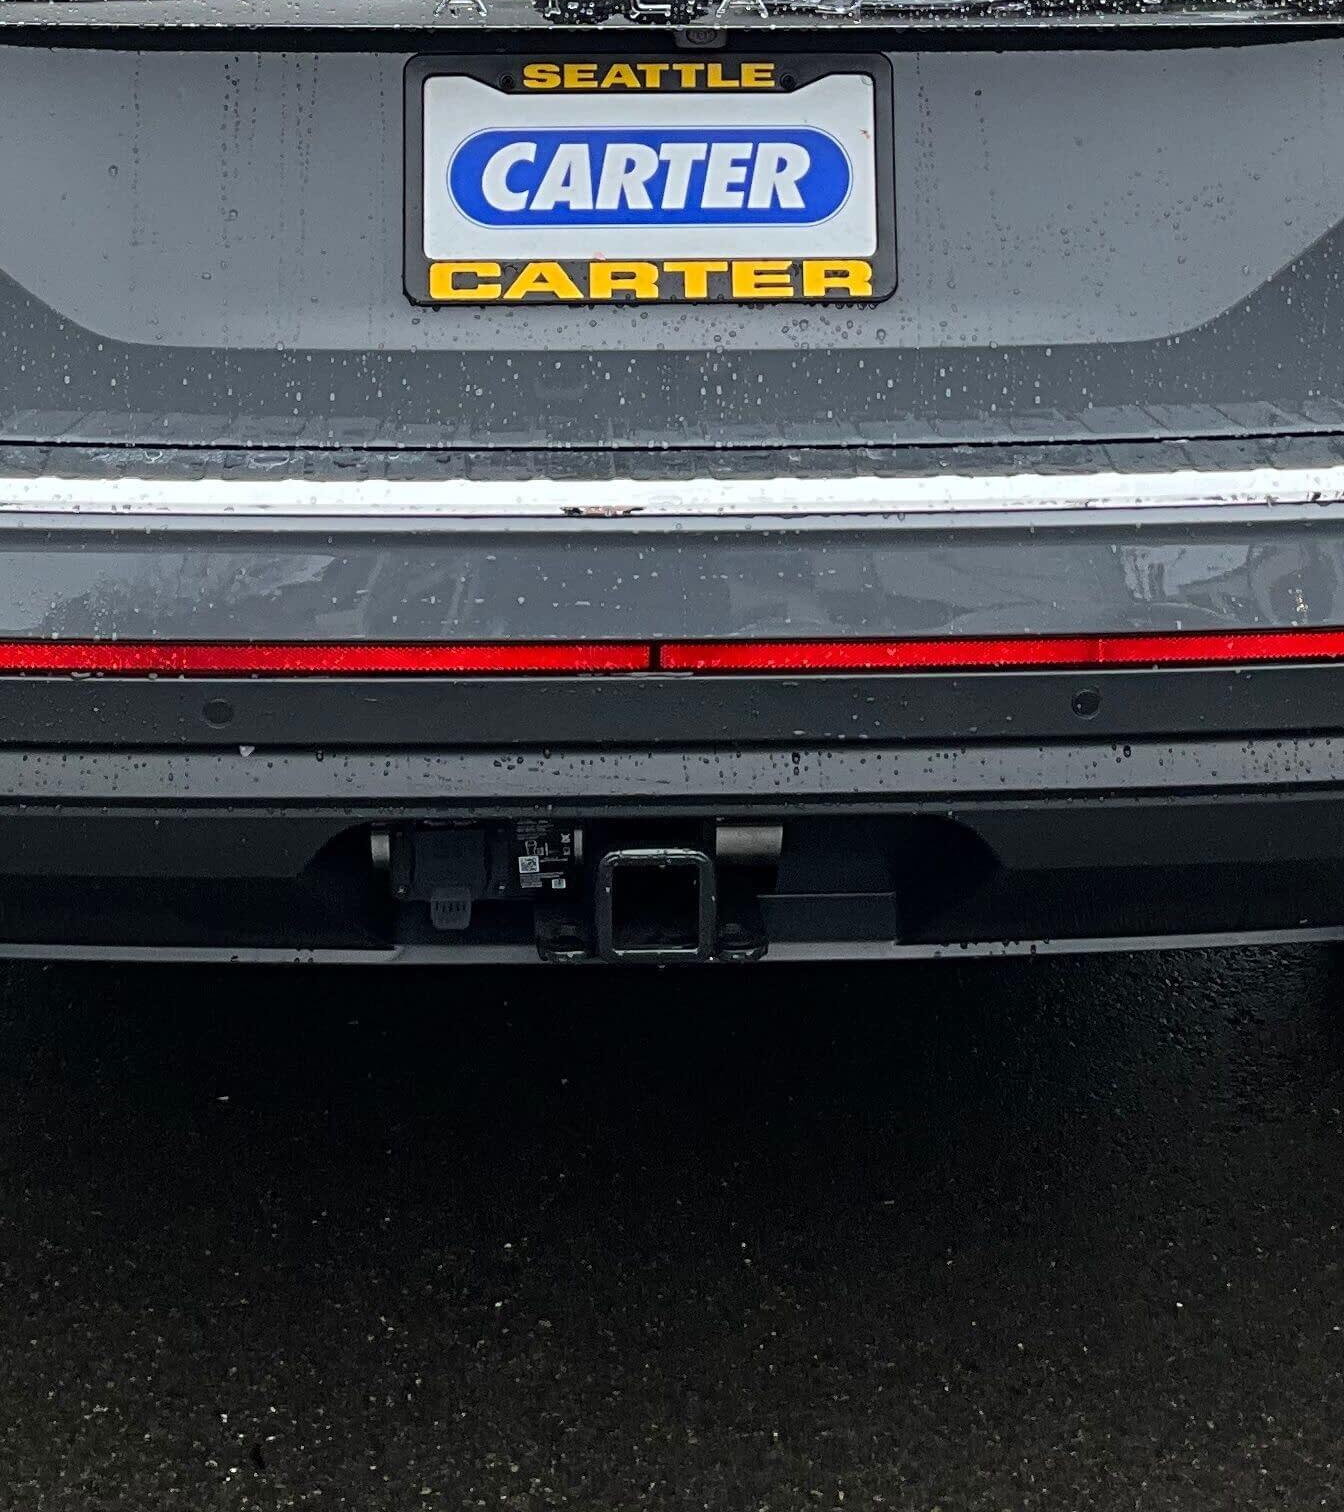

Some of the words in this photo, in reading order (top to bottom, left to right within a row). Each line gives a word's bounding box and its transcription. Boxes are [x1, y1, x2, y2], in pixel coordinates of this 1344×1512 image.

[522, 62, 775, 90] SEATTLE
[480, 141, 811, 214] CARTER
[428, 259, 874, 301] CARTER
